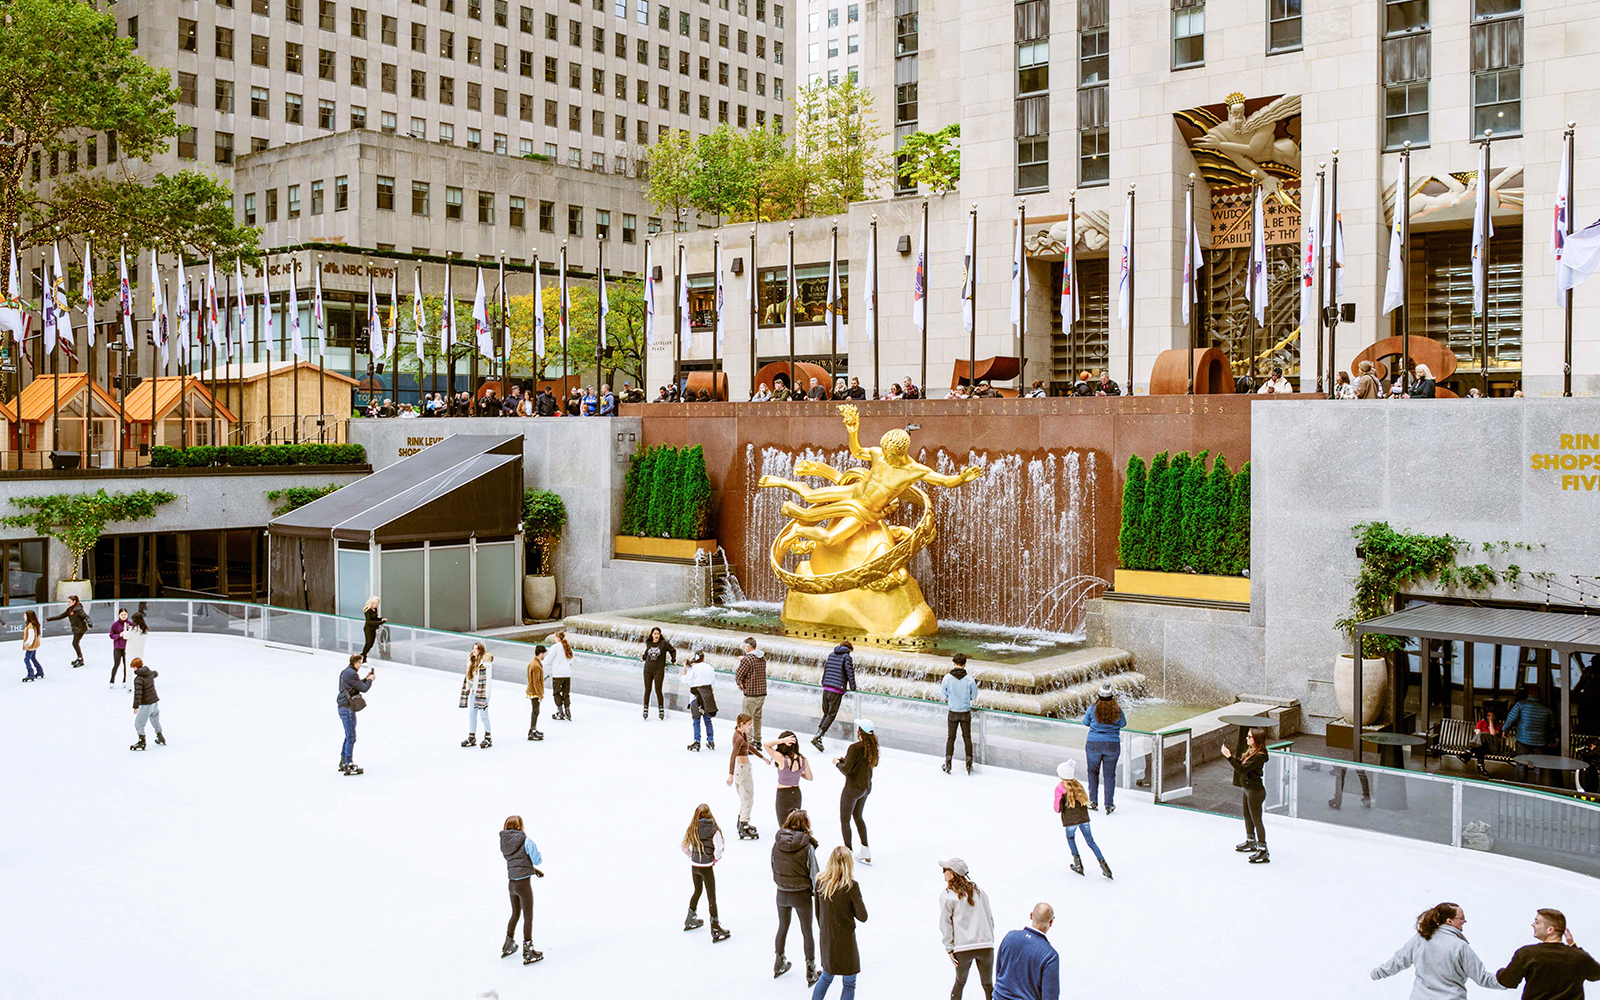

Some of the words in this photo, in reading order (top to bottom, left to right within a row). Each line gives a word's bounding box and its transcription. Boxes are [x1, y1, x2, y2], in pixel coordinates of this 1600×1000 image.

[1212, 208, 1248, 220] WISDO
[1273, 217, 1284, 227] BE
[1212, 233, 1251, 246] STABILIT
[1279, 228, 1298, 240] THY
[269, 264, 281, 276] NBC
[343, 264, 363, 276] NBC
[367, 266, 394, 279] NEWS
[1161, 397, 1209, 405] FIRE
[967, 408, 1021, 416] MEANS
[1077, 407, 1152, 415] MIGHTY
[1175, 406, 1224, 414] ENDS
[407, 437, 424, 446] RINK
[1531, 454, 1600, 471] SHOPS
